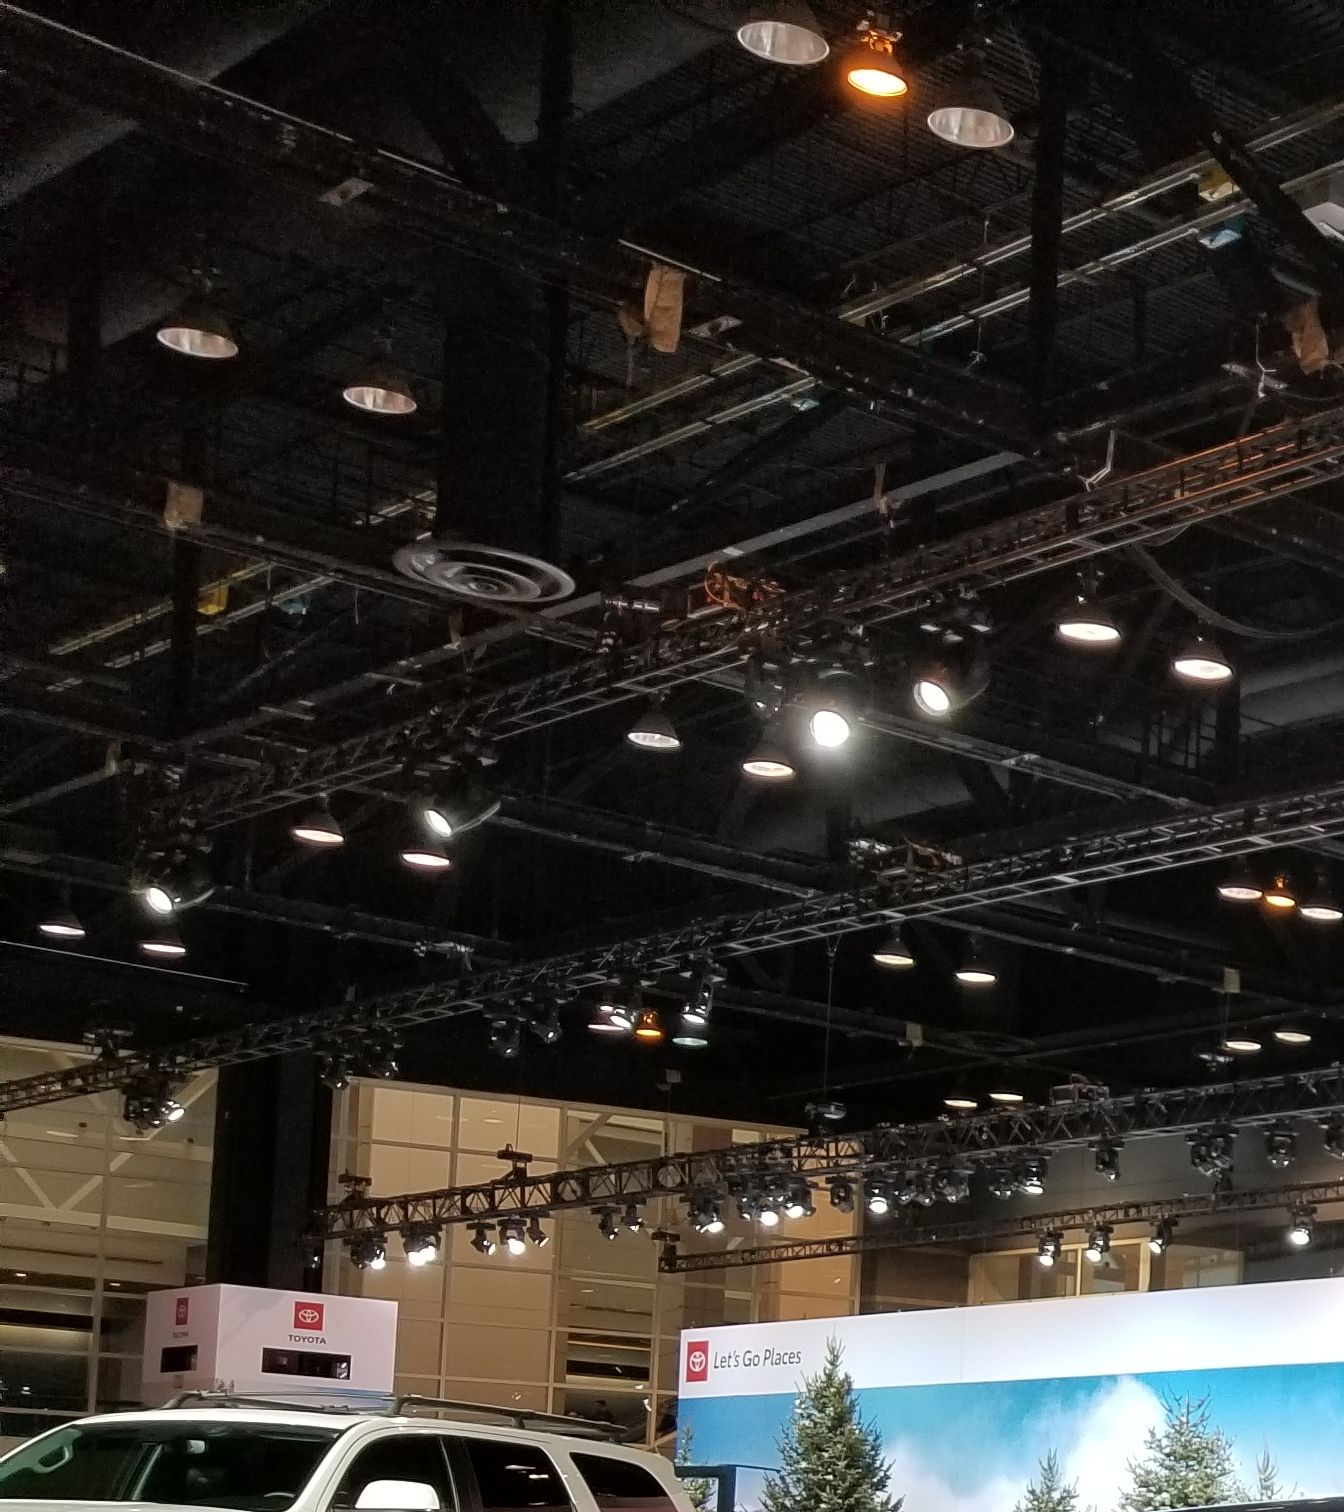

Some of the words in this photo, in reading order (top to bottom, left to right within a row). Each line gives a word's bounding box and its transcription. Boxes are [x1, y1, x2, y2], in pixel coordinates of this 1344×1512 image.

[288, 1334, 327, 1345] TOYOTA
[743, 1349, 760, 1367] Go
[763, 1347, 801, 1366] Places
